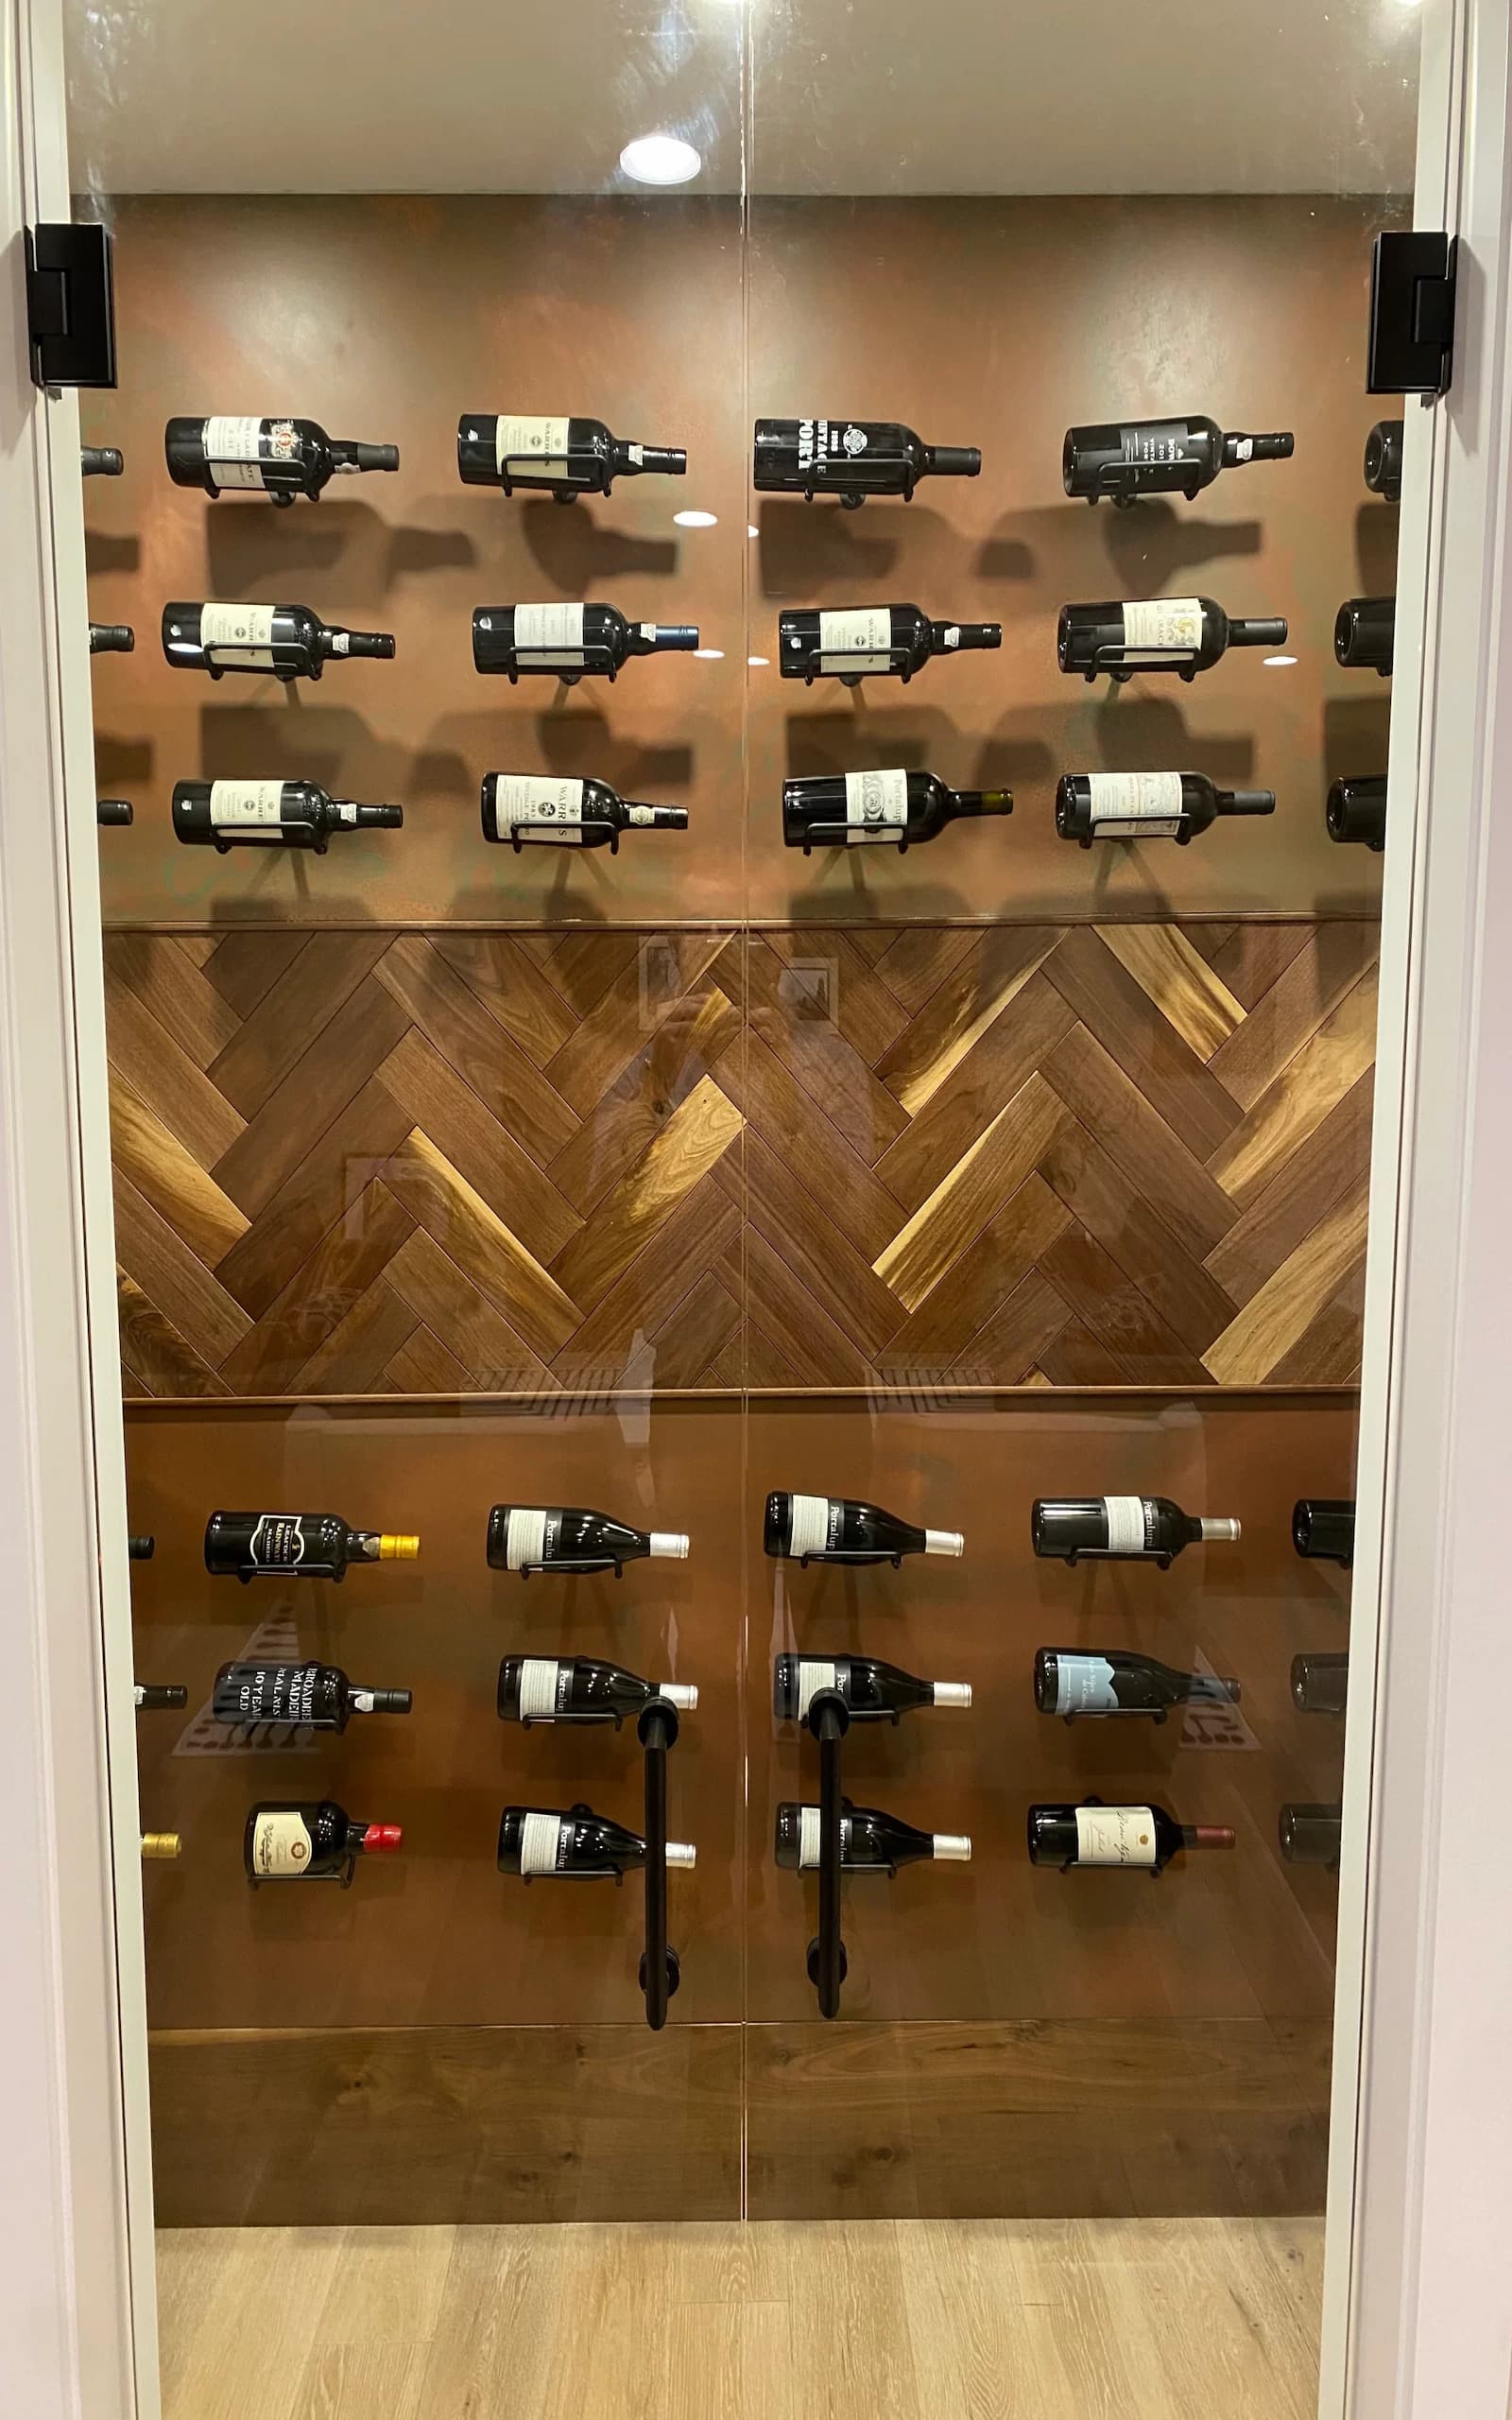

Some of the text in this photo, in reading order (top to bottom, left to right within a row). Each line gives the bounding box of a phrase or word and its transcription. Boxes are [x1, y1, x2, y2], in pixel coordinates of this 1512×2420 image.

[799, 419, 814, 470] PORT
[558, 786, 568, 837] WARRS
[894, 779, 904, 821] Portalup
[826, 1506, 839, 1550] Portalup
[239, 1685, 250, 1711] OLD
[255, 1670, 266, 1685] 10
[272, 1668, 287, 1717] MALMS
[301, 1668, 318, 1720] BROADBE
